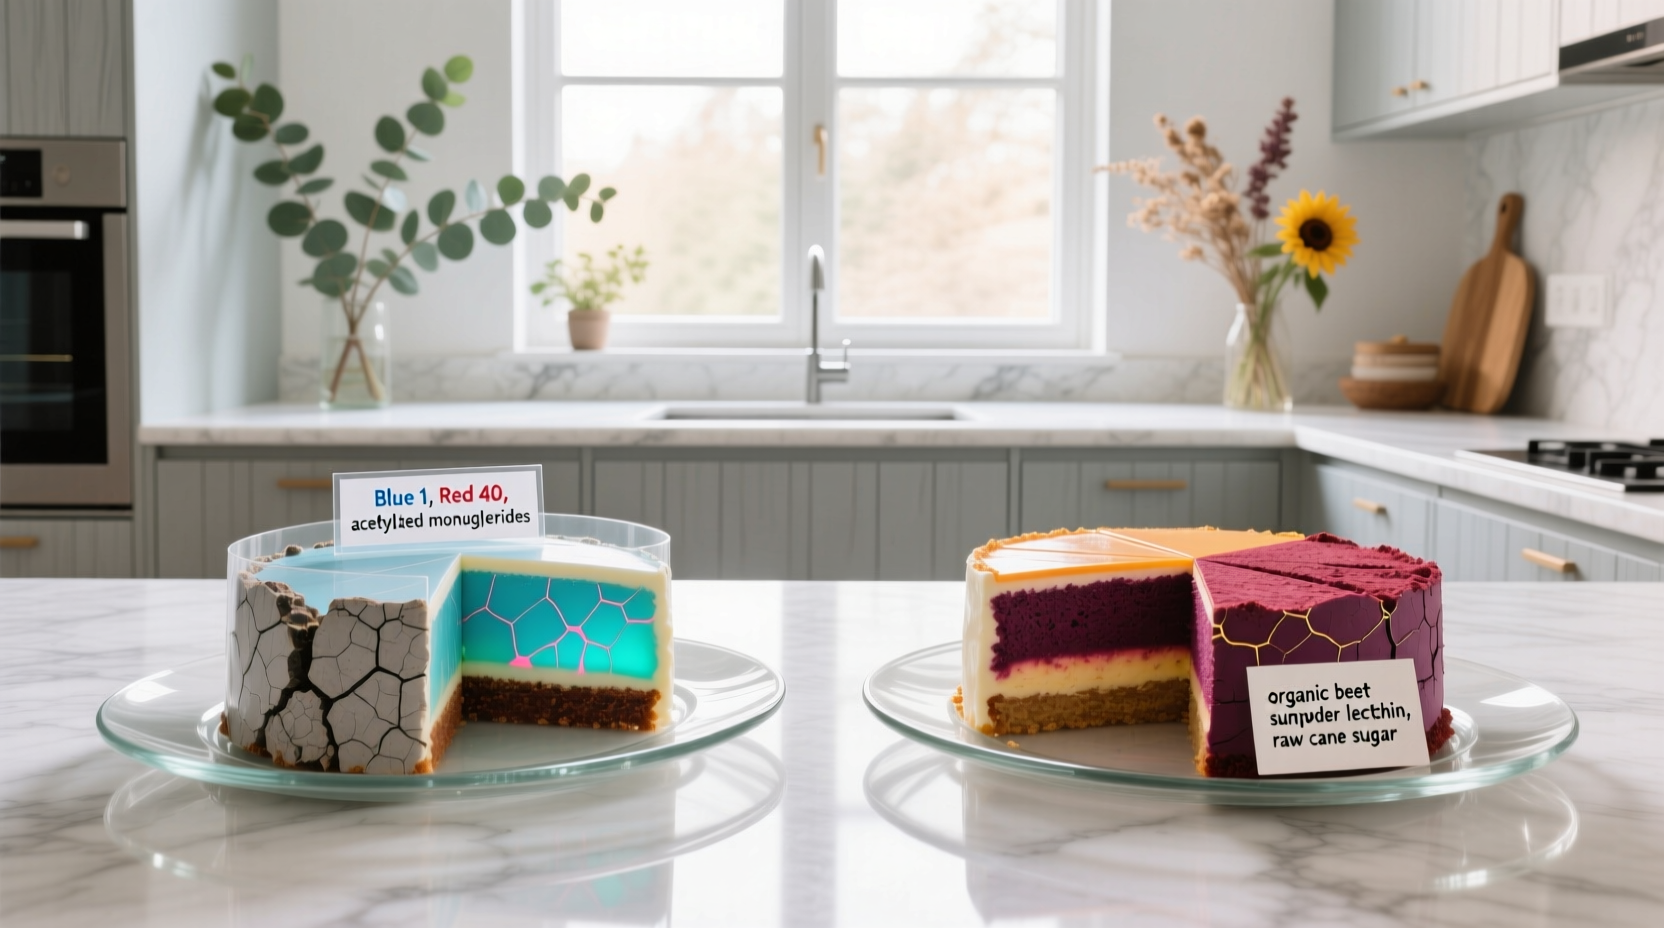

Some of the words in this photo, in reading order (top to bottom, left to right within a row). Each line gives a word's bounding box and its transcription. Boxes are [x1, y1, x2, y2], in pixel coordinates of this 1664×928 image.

[375, 487, 414, 507] Blue
[419, 486, 433, 508] 1,
[439, 484, 473, 504] Red
[479, 484, 508, 504] 40,
[429, 508, 530, 530] monuglerides
[1268, 684, 1329, 708] organic
[1335, 682, 1371, 700] beet
[1273, 733, 1304, 748] raw
[1309, 731, 1347, 746] cane
[1352, 728, 1397, 747] sugar
